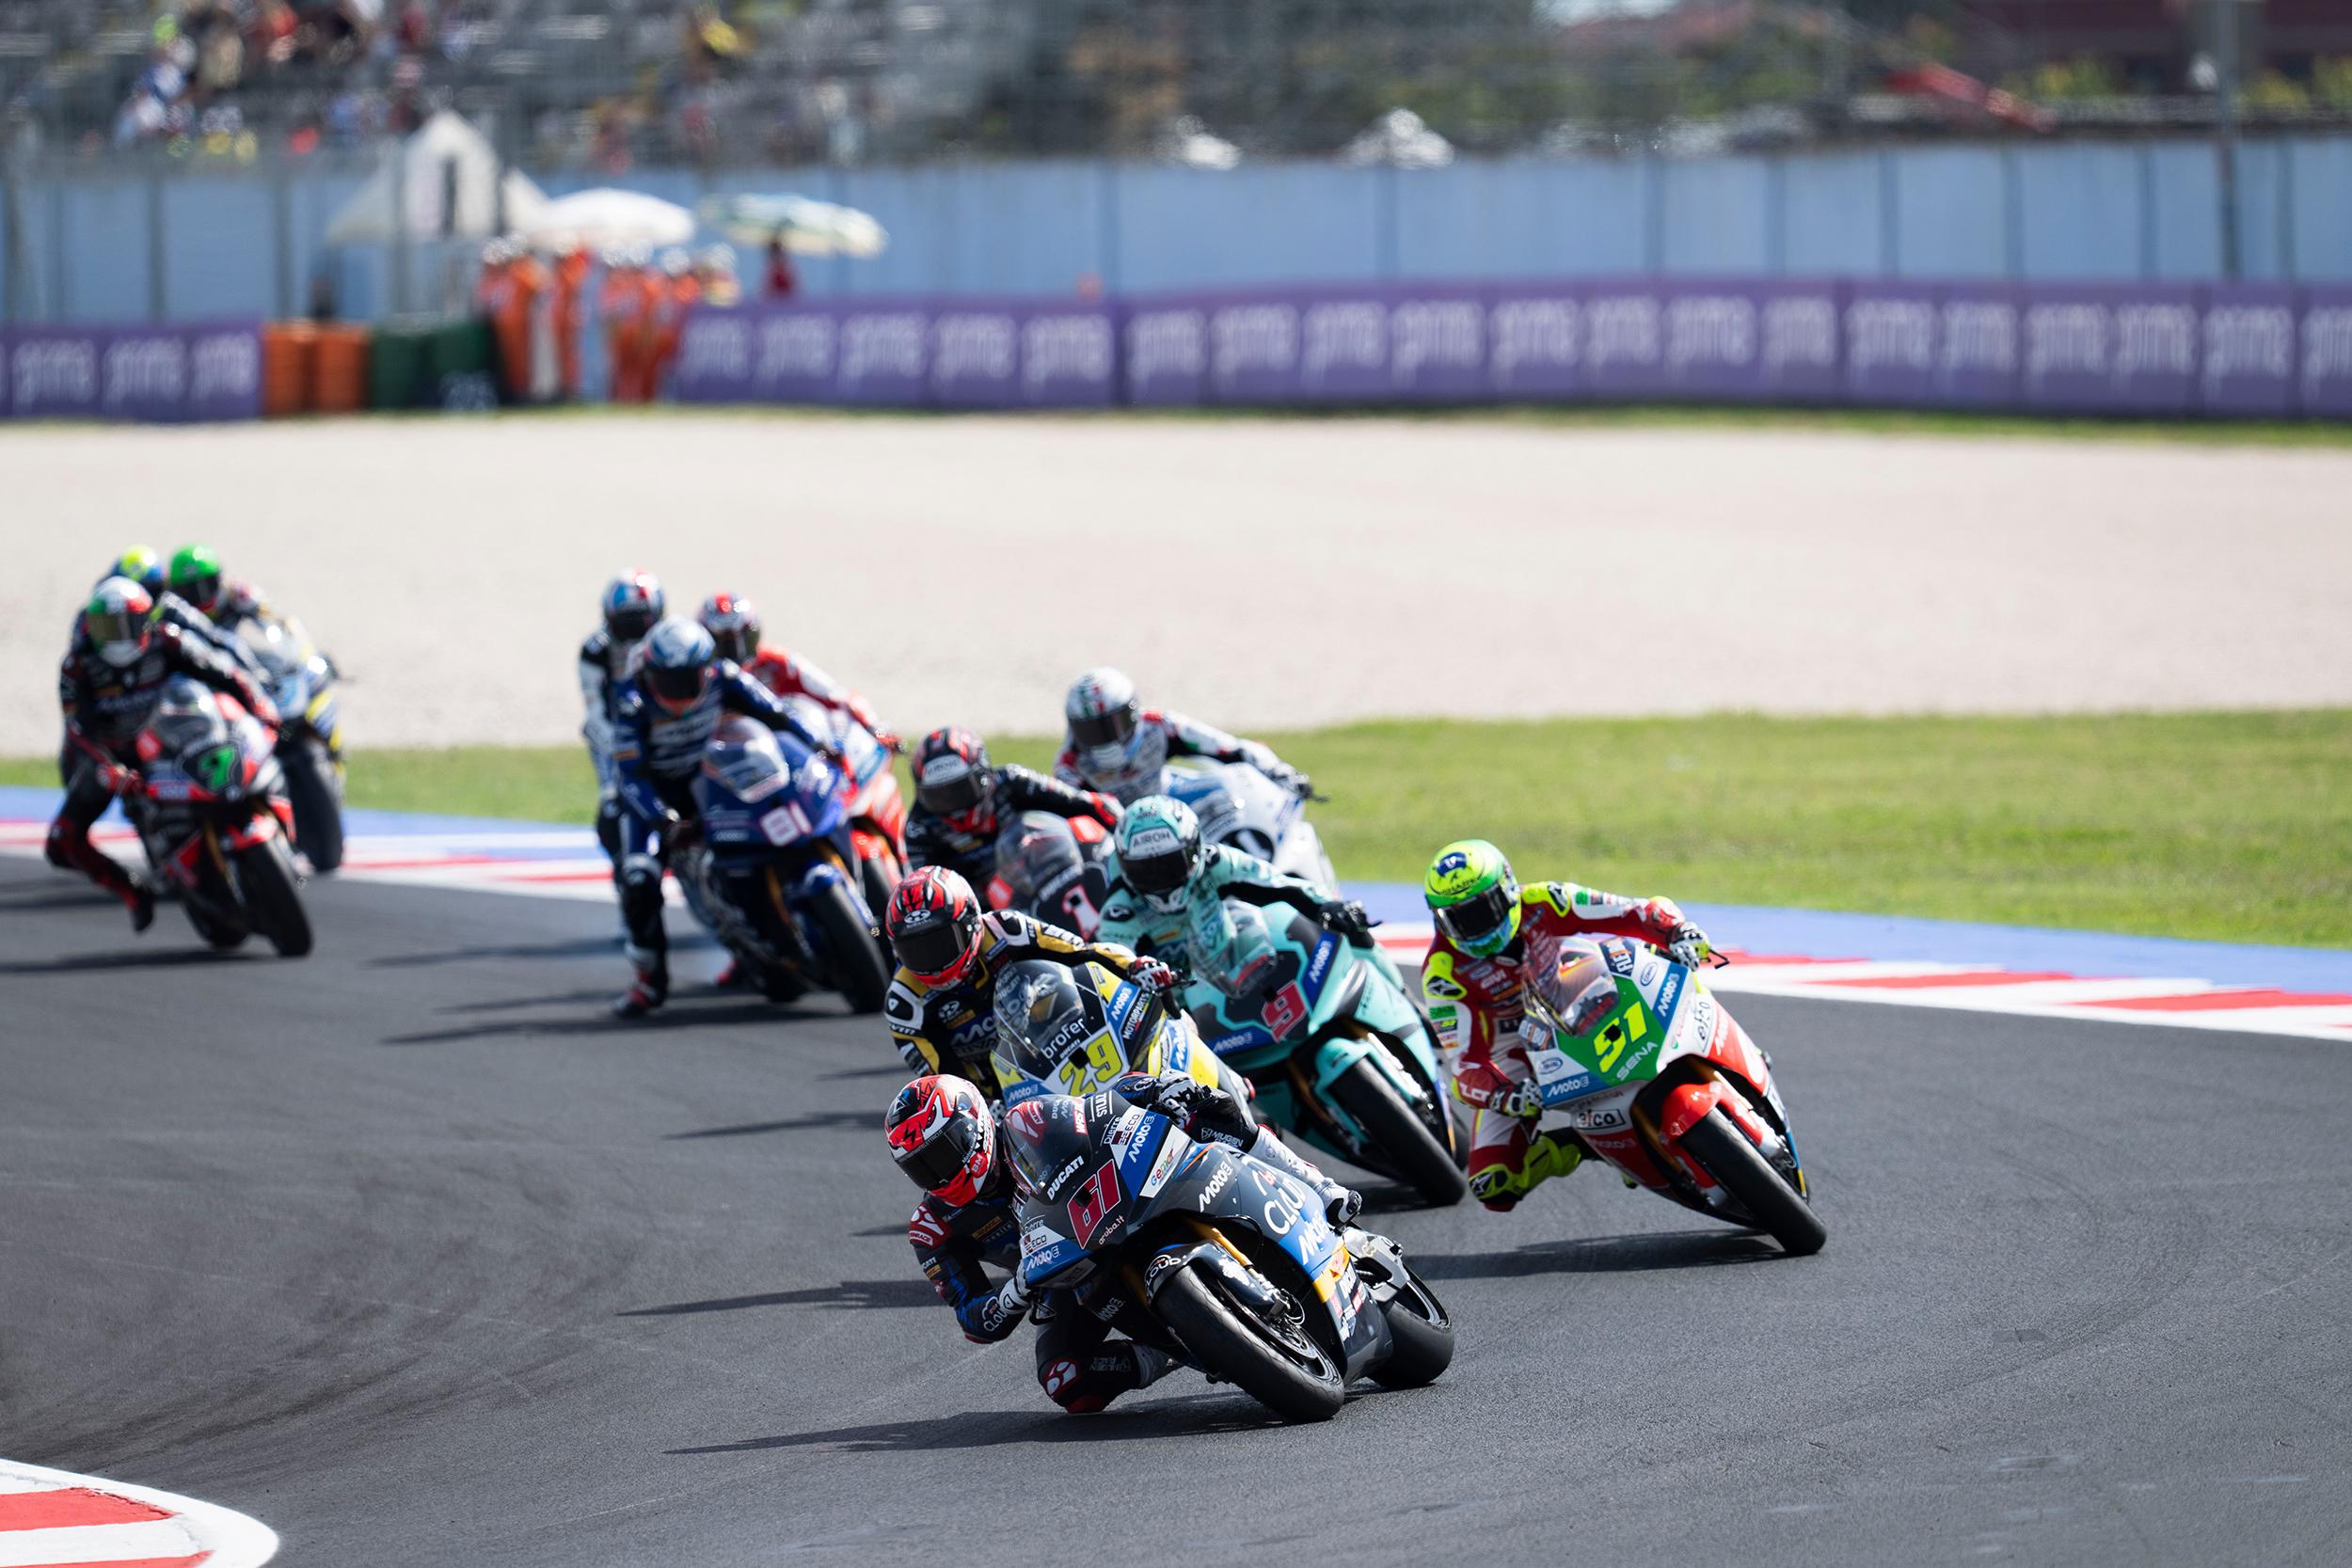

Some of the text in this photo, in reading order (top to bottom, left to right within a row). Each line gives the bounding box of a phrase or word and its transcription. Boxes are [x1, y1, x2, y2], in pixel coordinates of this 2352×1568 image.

[1133, 831, 1171, 847] AIROH
[1122, 991, 1150, 1040] MOTORPARTS
[1261, 979, 1308, 1043] 9
[1041, 1018, 1085, 1060] brofer
[1593, 1000, 1648, 1073] 51
[1058, 1030, 1124, 1098] 29
[1616, 1041, 1659, 1082] SENA
[1046, 1155, 1085, 1201] DUCATI
[1067, 1158, 1122, 1250] 61
[1098, 1214, 1125, 1246] aruba.it
